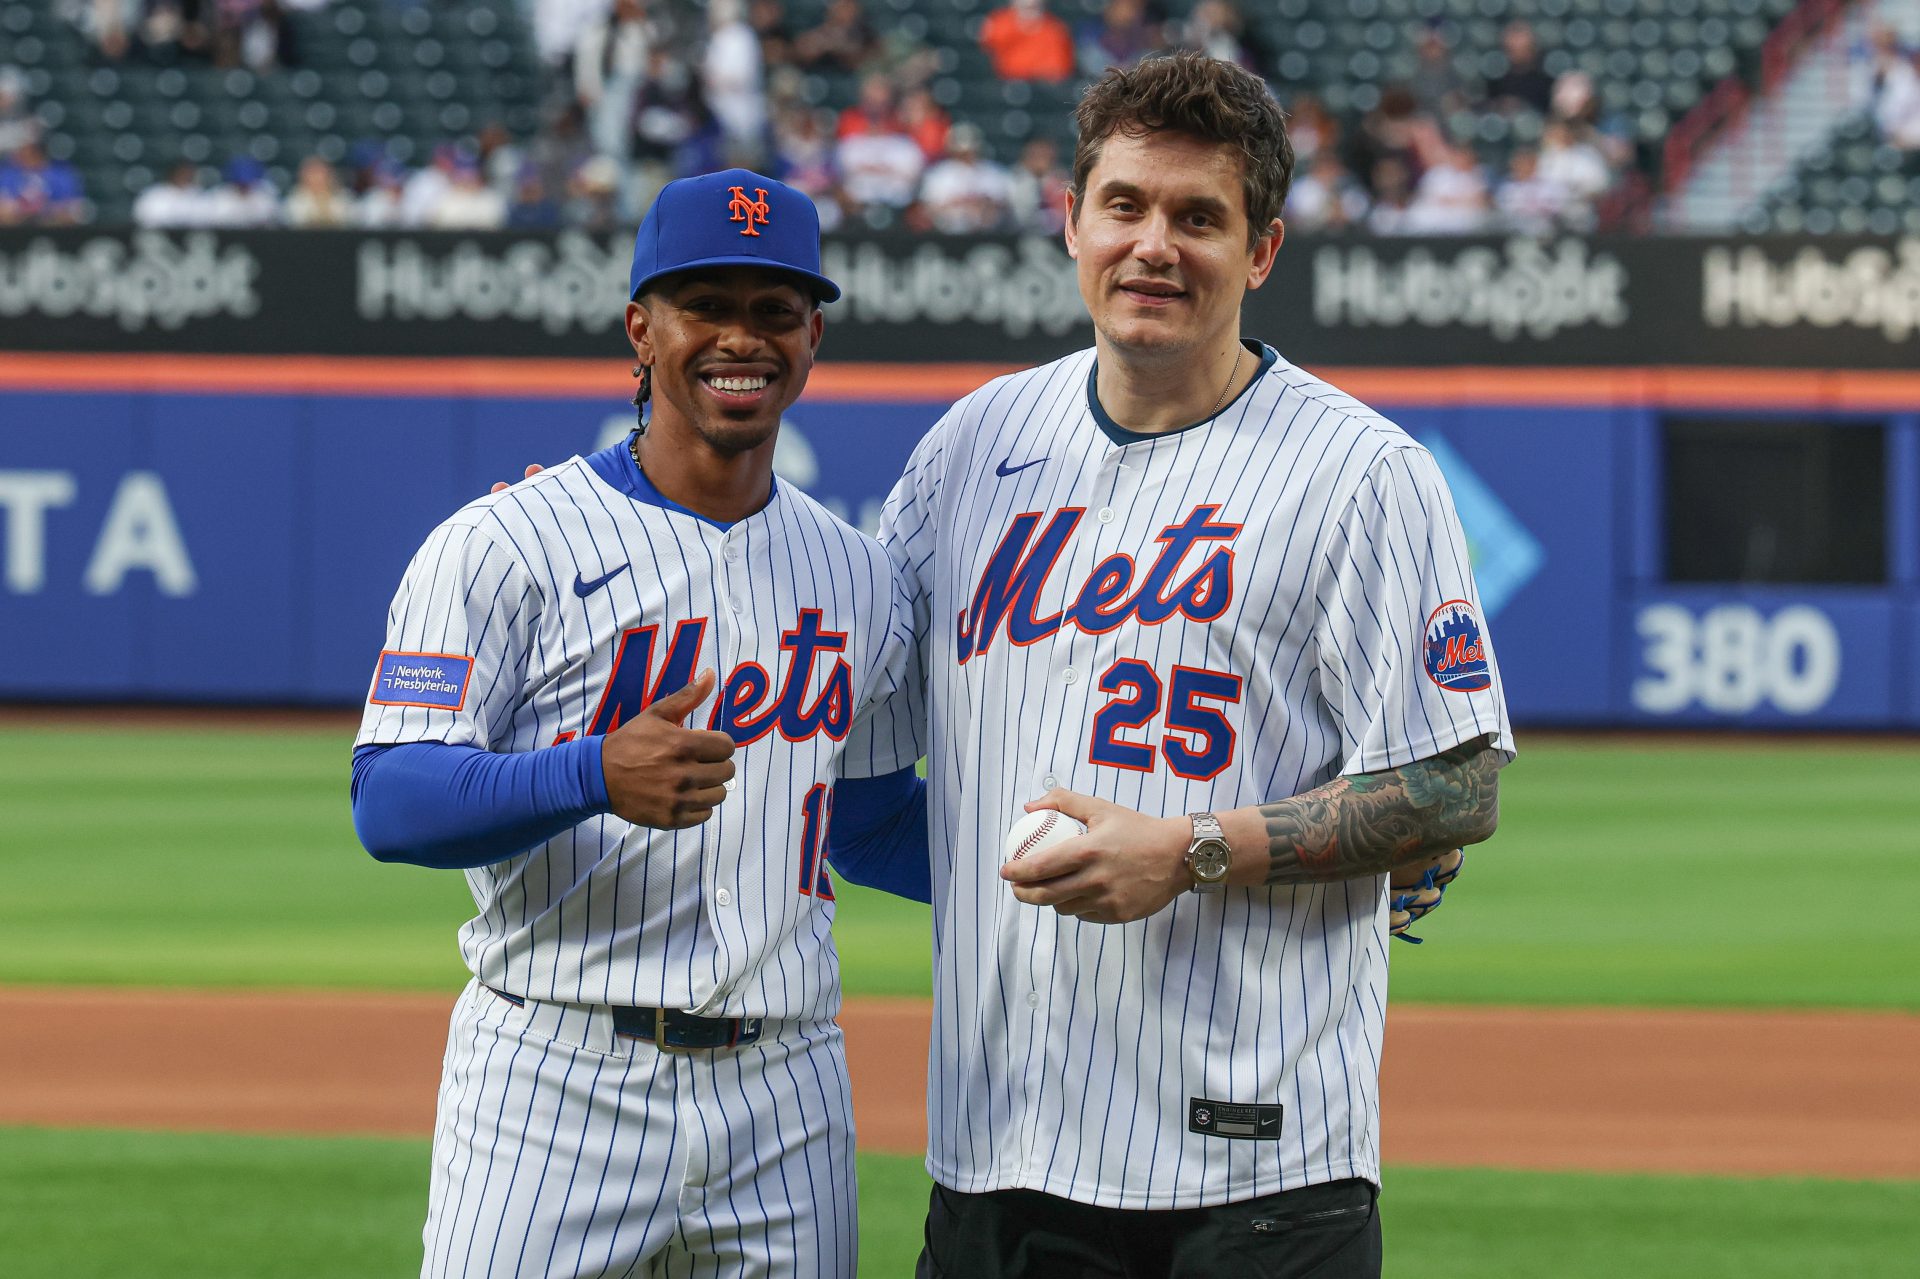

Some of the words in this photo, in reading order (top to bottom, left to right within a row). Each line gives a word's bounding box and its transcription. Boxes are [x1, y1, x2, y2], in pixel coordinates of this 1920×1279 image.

[0, 469, 198, 597] TA
[954, 504, 1244, 665] Mets
[393, 677, 458, 694] Presbyterian
[396, 665, 446, 680] NewYork-
[551, 607, 853, 748] Mets
[1437, 631, 1489, 672] Met
[1632, 602, 1842, 716] 380
[1088, 657, 1243, 782] 25
